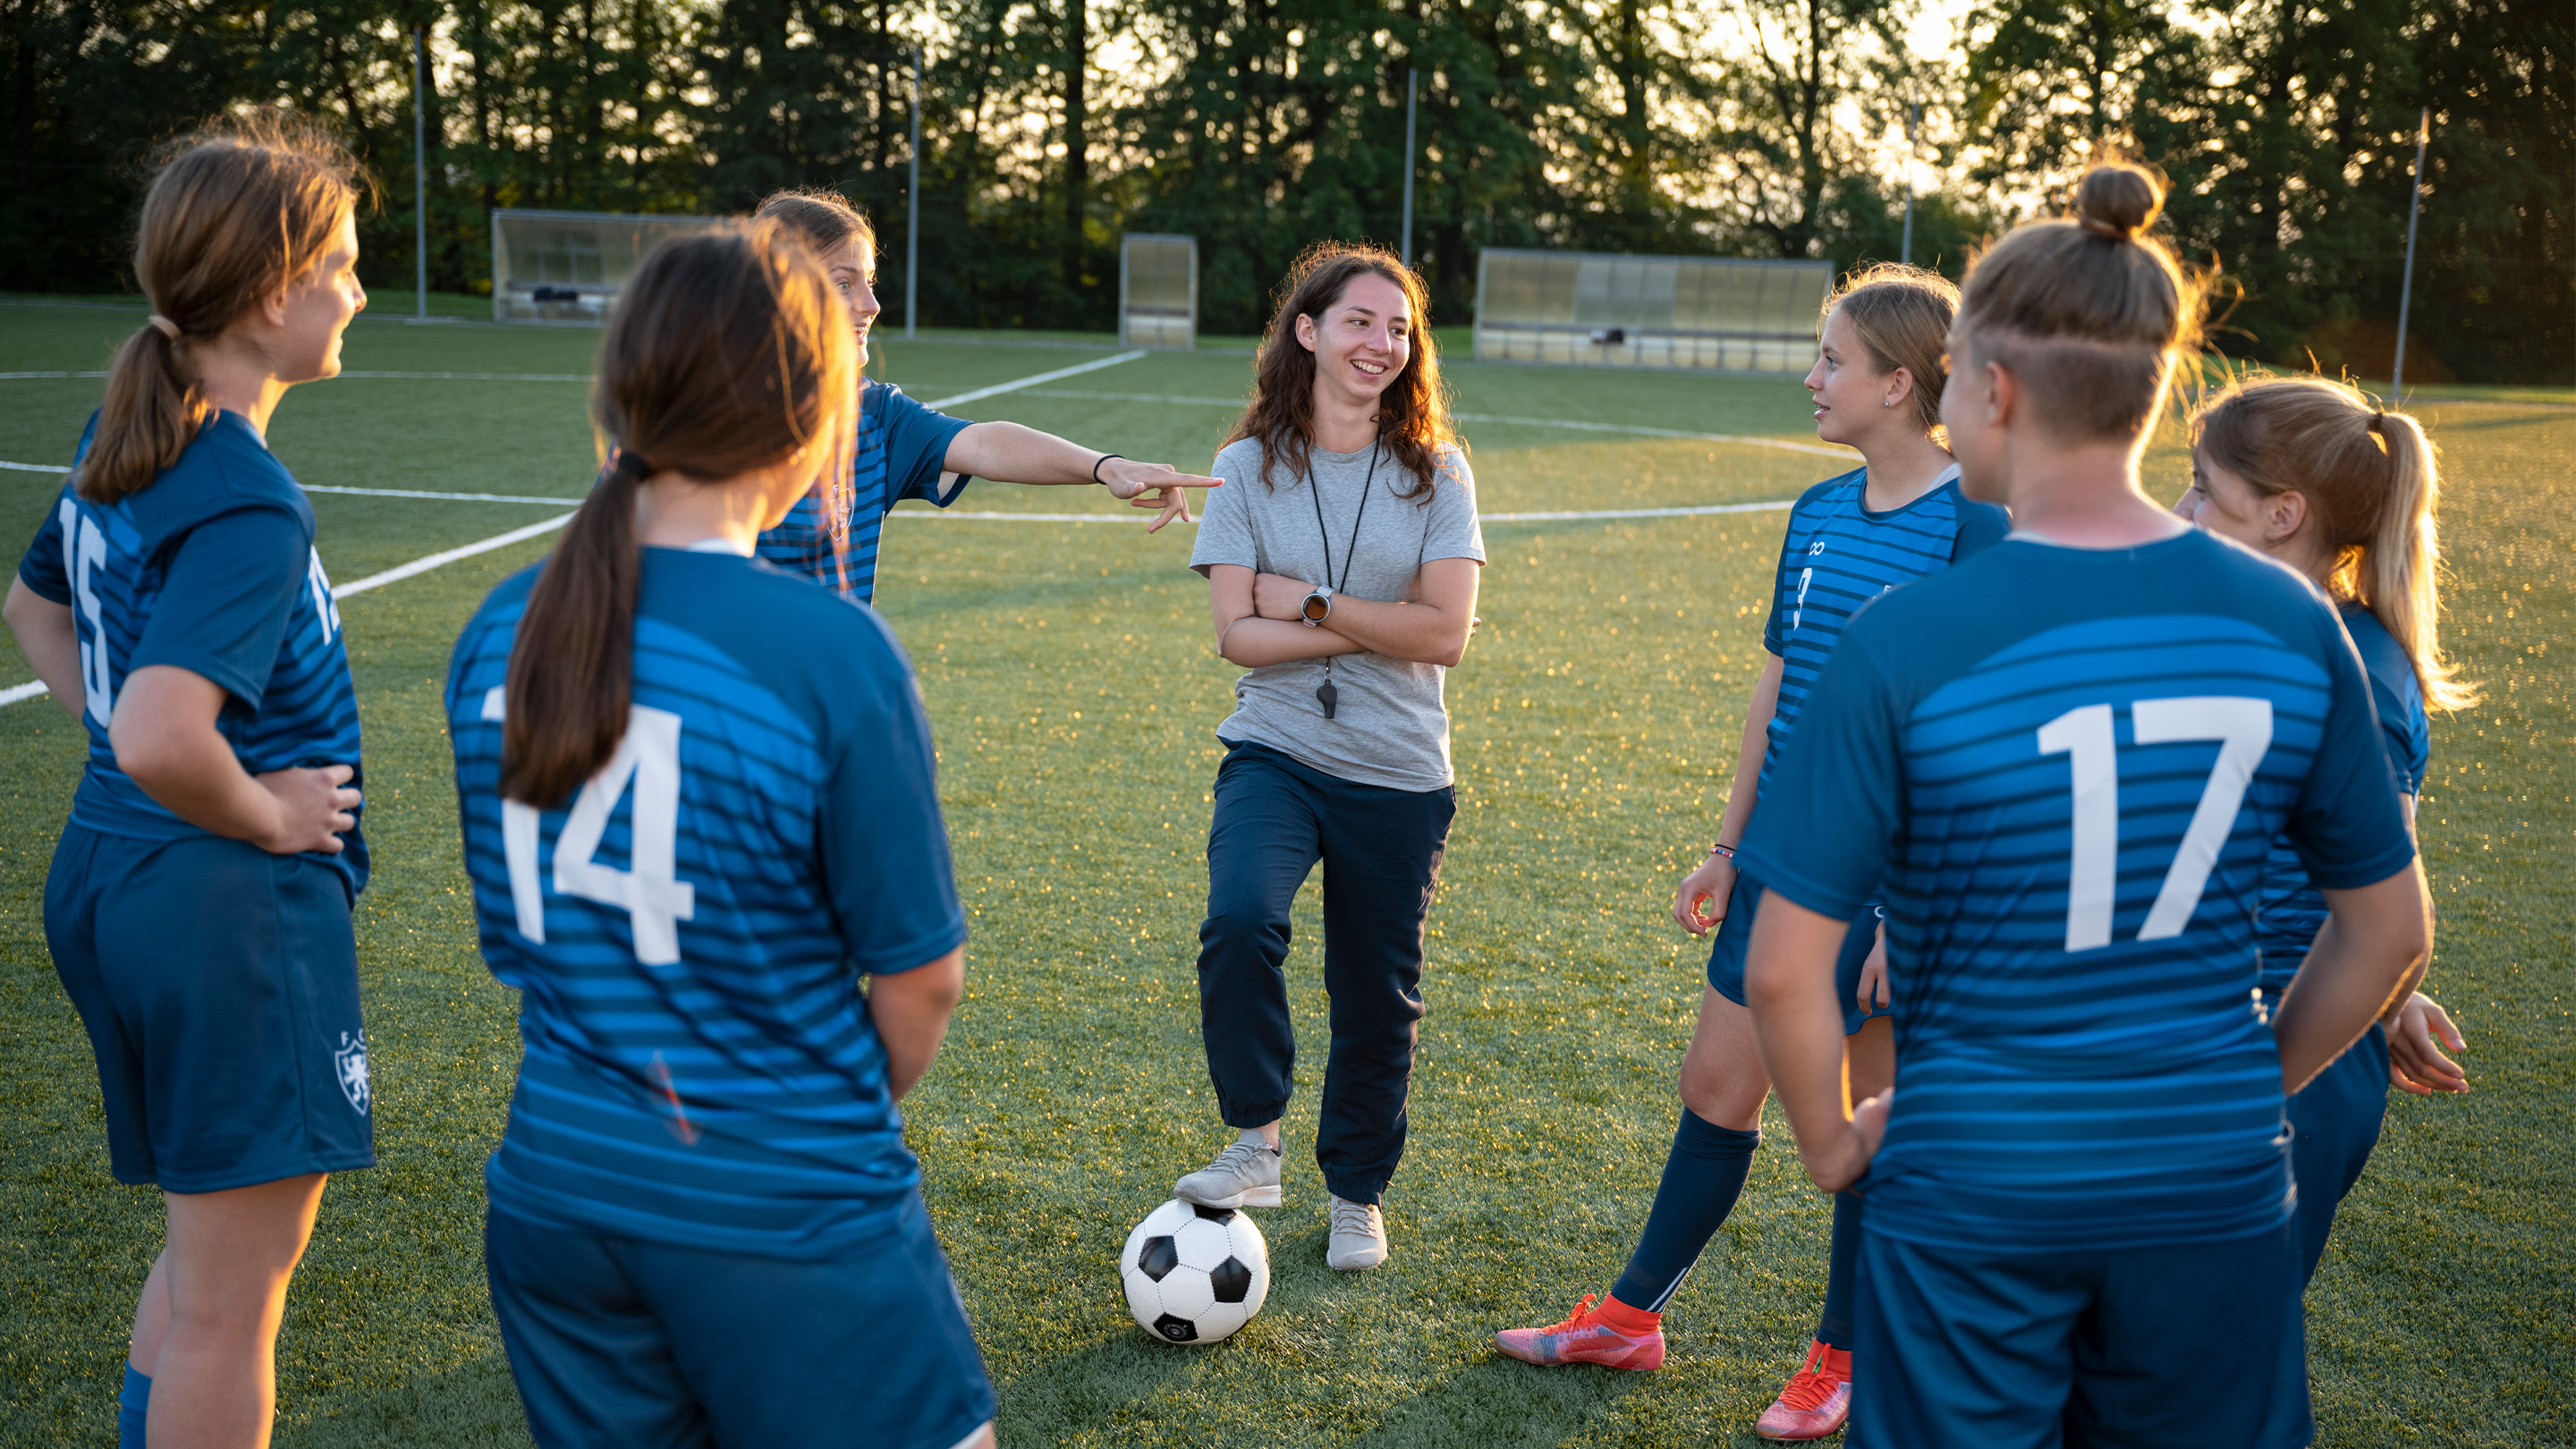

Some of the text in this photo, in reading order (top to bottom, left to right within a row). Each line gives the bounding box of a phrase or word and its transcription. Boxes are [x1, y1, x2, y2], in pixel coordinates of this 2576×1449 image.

[58, 497, 112, 729] 15
[479, 684, 695, 966] 14
[2036, 695, 2274, 953] 17
